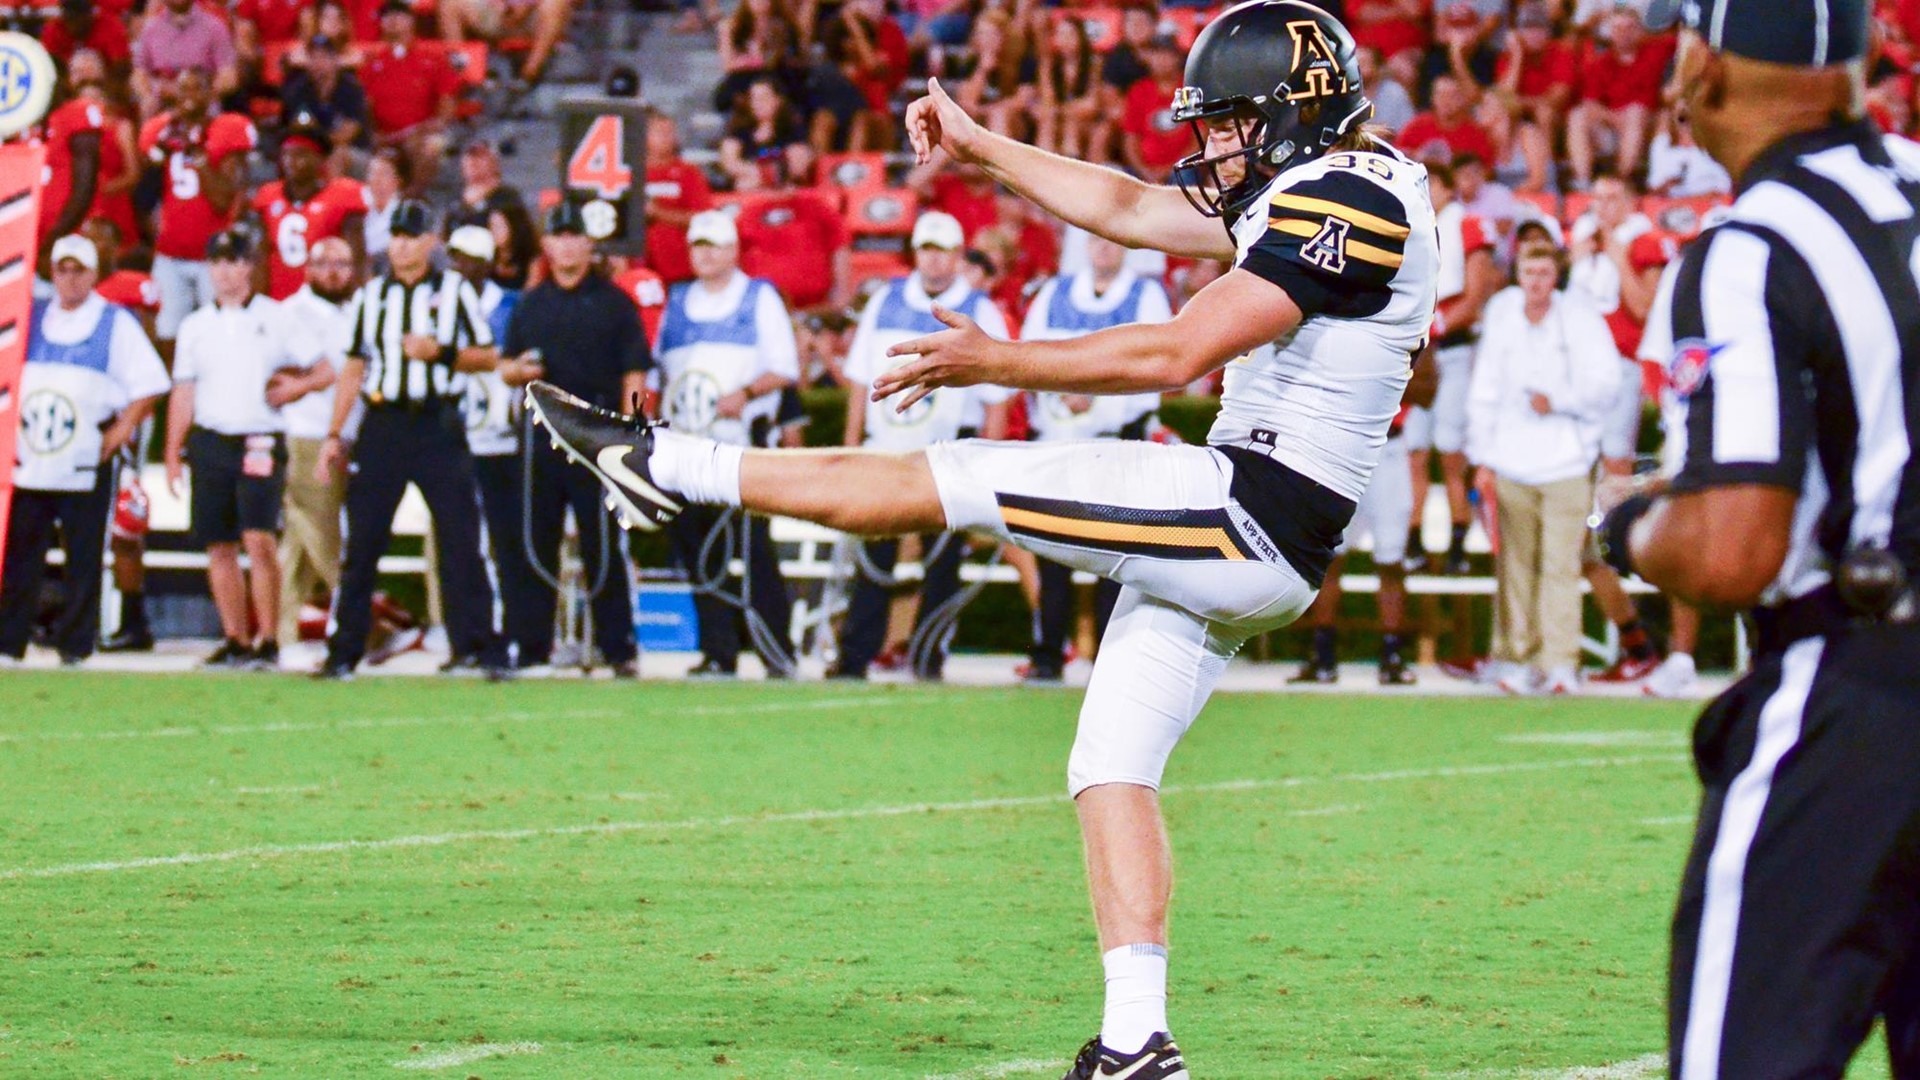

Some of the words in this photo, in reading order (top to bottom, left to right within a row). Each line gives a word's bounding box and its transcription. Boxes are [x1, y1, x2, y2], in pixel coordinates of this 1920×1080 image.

[1285, 20, 1347, 100] A
[169, 150, 200, 200] 5
[567, 114, 632, 199] 4
[277, 212, 309, 268] 6
[1299, 215, 1350, 274] A
[1242, 519, 1258, 537] APP
[1255, 535, 1278, 564] STATE
